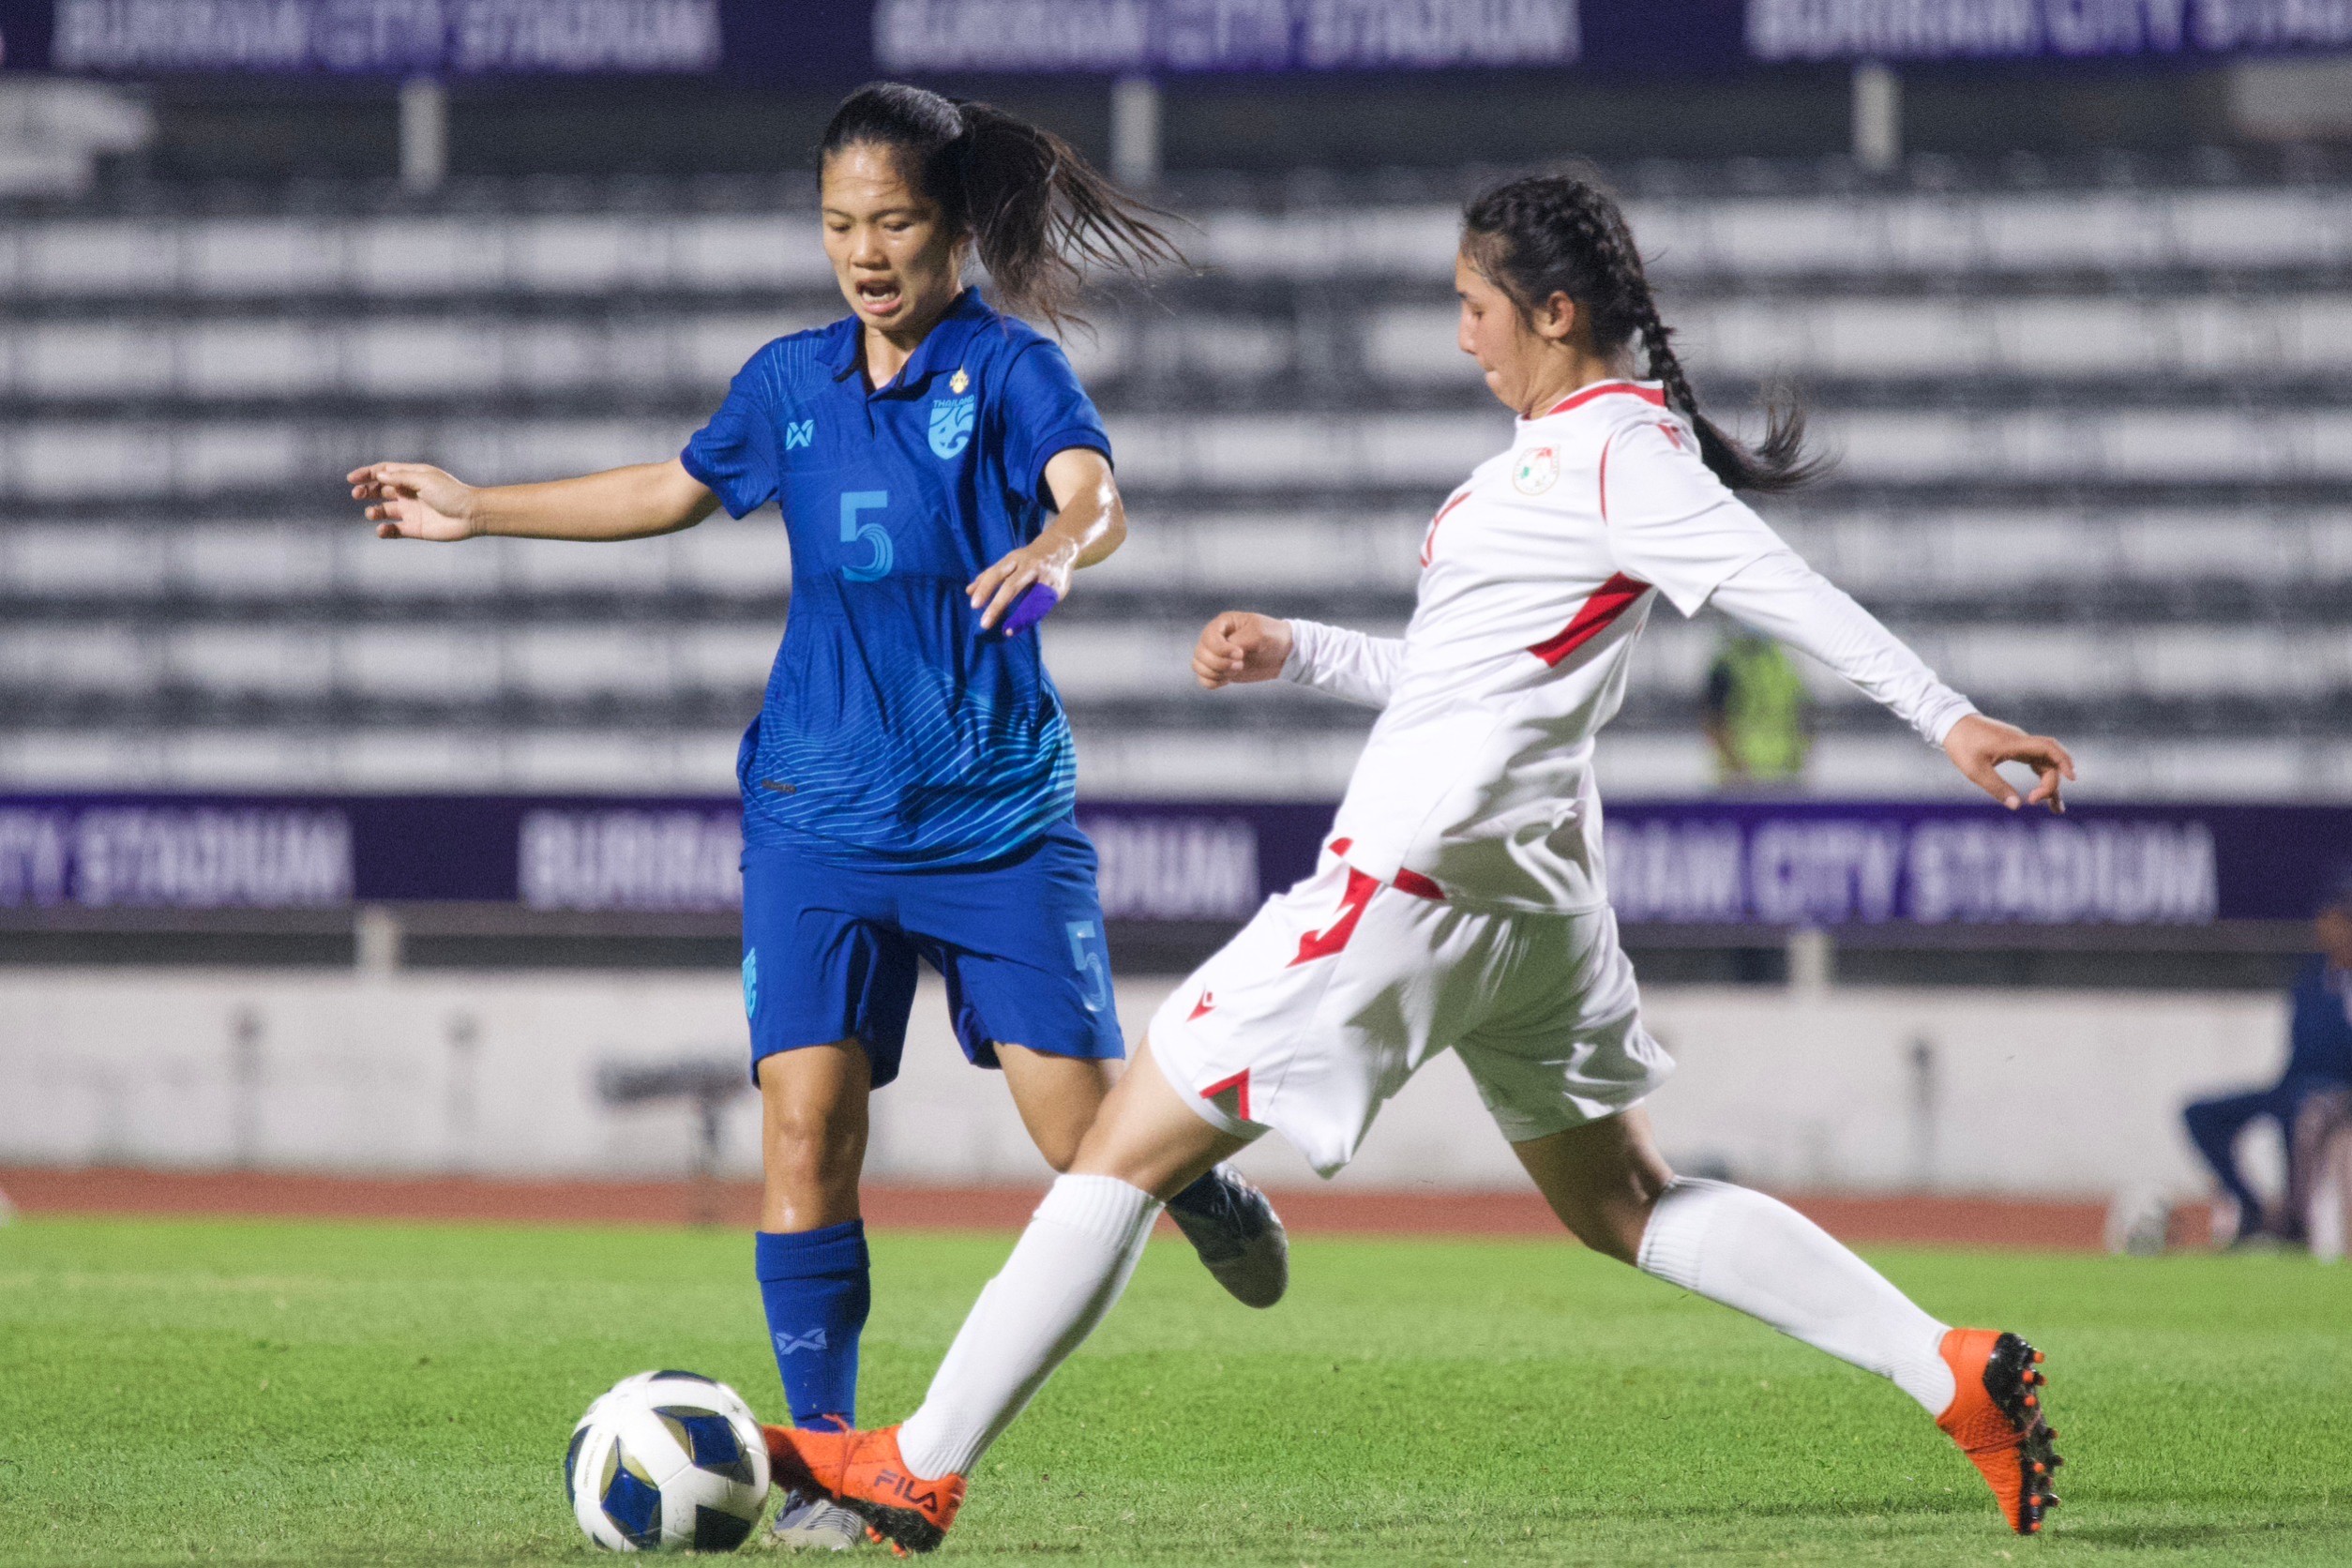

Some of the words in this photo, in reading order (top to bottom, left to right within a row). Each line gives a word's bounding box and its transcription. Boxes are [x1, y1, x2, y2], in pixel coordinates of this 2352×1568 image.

[932, 394, 975, 408] THAILAND
[840, 490, 893, 581] 5
[1751, 818, 1905, 920] CITY
[1907, 819, 2218, 922] STADIUM
[1065, 920, 1107, 1012] 5
[874, 1469, 938, 1515] FILA
